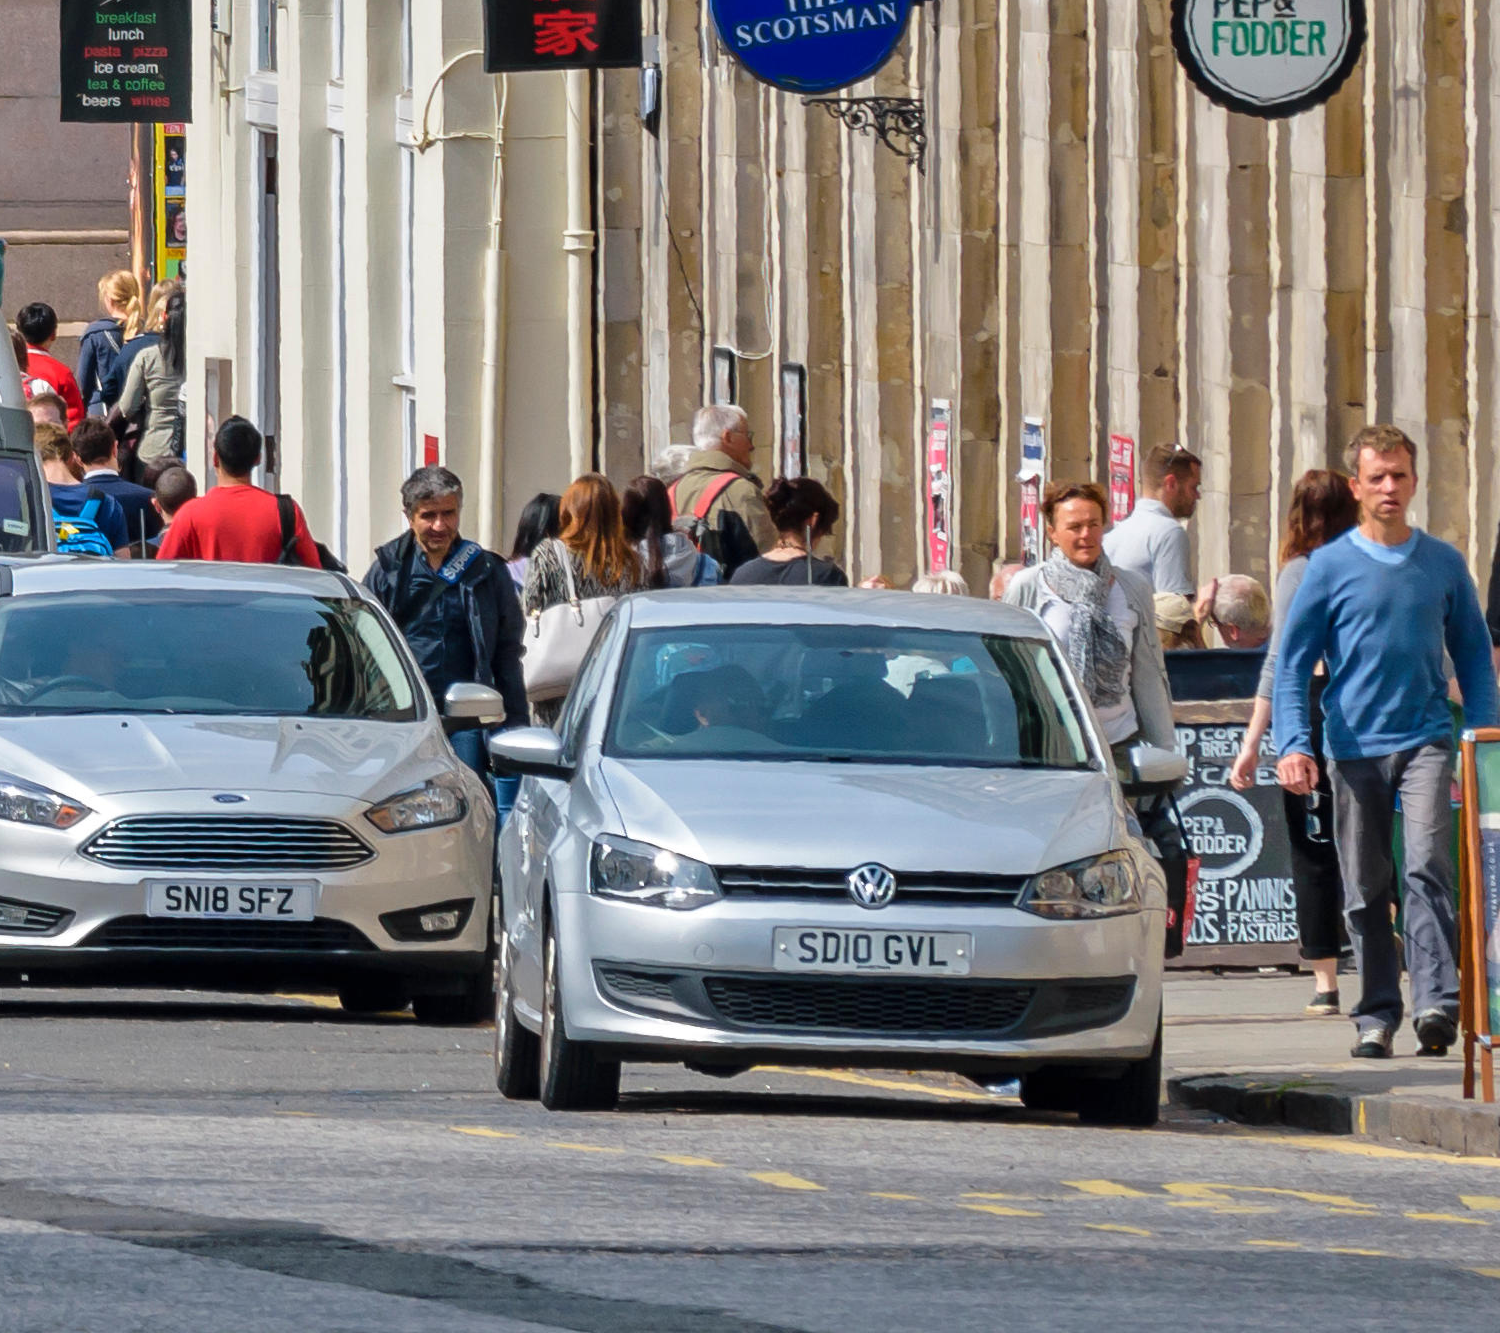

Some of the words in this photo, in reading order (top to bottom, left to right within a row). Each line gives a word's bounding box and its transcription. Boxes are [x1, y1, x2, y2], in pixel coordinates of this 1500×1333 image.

[95, 12, 157, 24] breakfast
[735, 1, 898, 48] SCOTSMAN
[108, 28, 145, 41] lunch
[1212, 20, 1327, 57] FODDER
[84, 46, 122, 59] pasta
[132, 46, 168, 59] pizza
[94, 61, 114, 74] ice
[117, 62, 159, 74] cream
[87, 78, 108, 91] tea
[112, 79, 121, 91] &
[125, 78, 166, 91] coffee
[82, 94, 122, 107] beers
[130, 95, 171, 108] wines
[164, 884, 227, 915] SN18
[238, 884, 295, 915] SFZ
[1227, 911, 1297, 924] FRESH
[1227, 922, 1299, 943] PASTRIES
[797, 935, 872, 967] SD10
[882, 935, 950, 969] GVL
